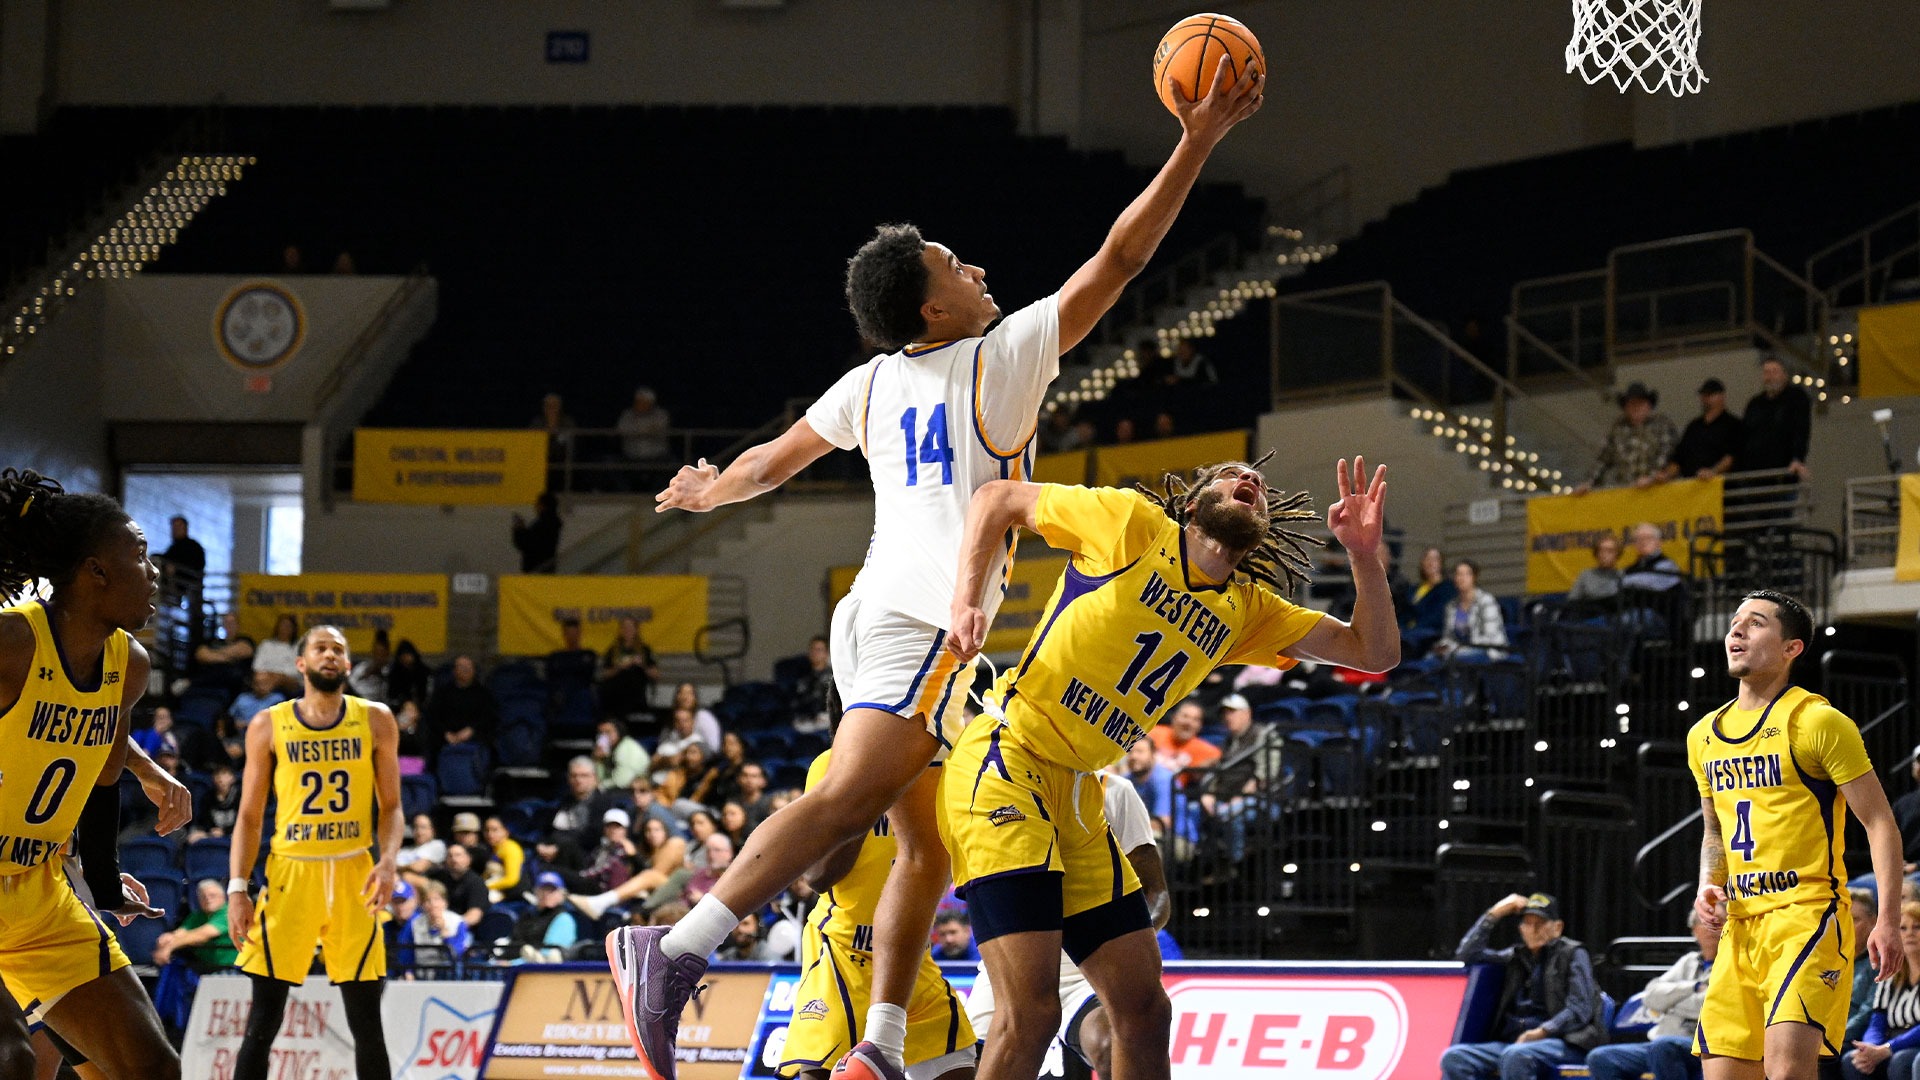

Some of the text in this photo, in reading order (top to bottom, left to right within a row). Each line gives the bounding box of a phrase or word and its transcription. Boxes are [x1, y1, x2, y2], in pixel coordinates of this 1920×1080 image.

[900, 402, 955, 487] 14
[1139, 570, 1232, 660] WESTERN
[1114, 629, 1191, 718] 14
[26, 700, 120, 747] WESTERN
[1059, 676, 1110, 727] NEW
[285, 737, 362, 763] WESTERN
[1703, 753, 1782, 793] WESTERN
[24, 756, 77, 825] 0
[301, 769, 350, 815] 23
[286, 820, 360, 841] NEW MEXICO
[1730, 799, 1755, 863] 4
[1736, 870, 1800, 898] MEXICO
[852, 924, 873, 952] NE
[416, 1029, 484, 1068] SON
[493, 1044, 542, 1057] Exotics
[543, 1044, 606, 1060] Breeding
